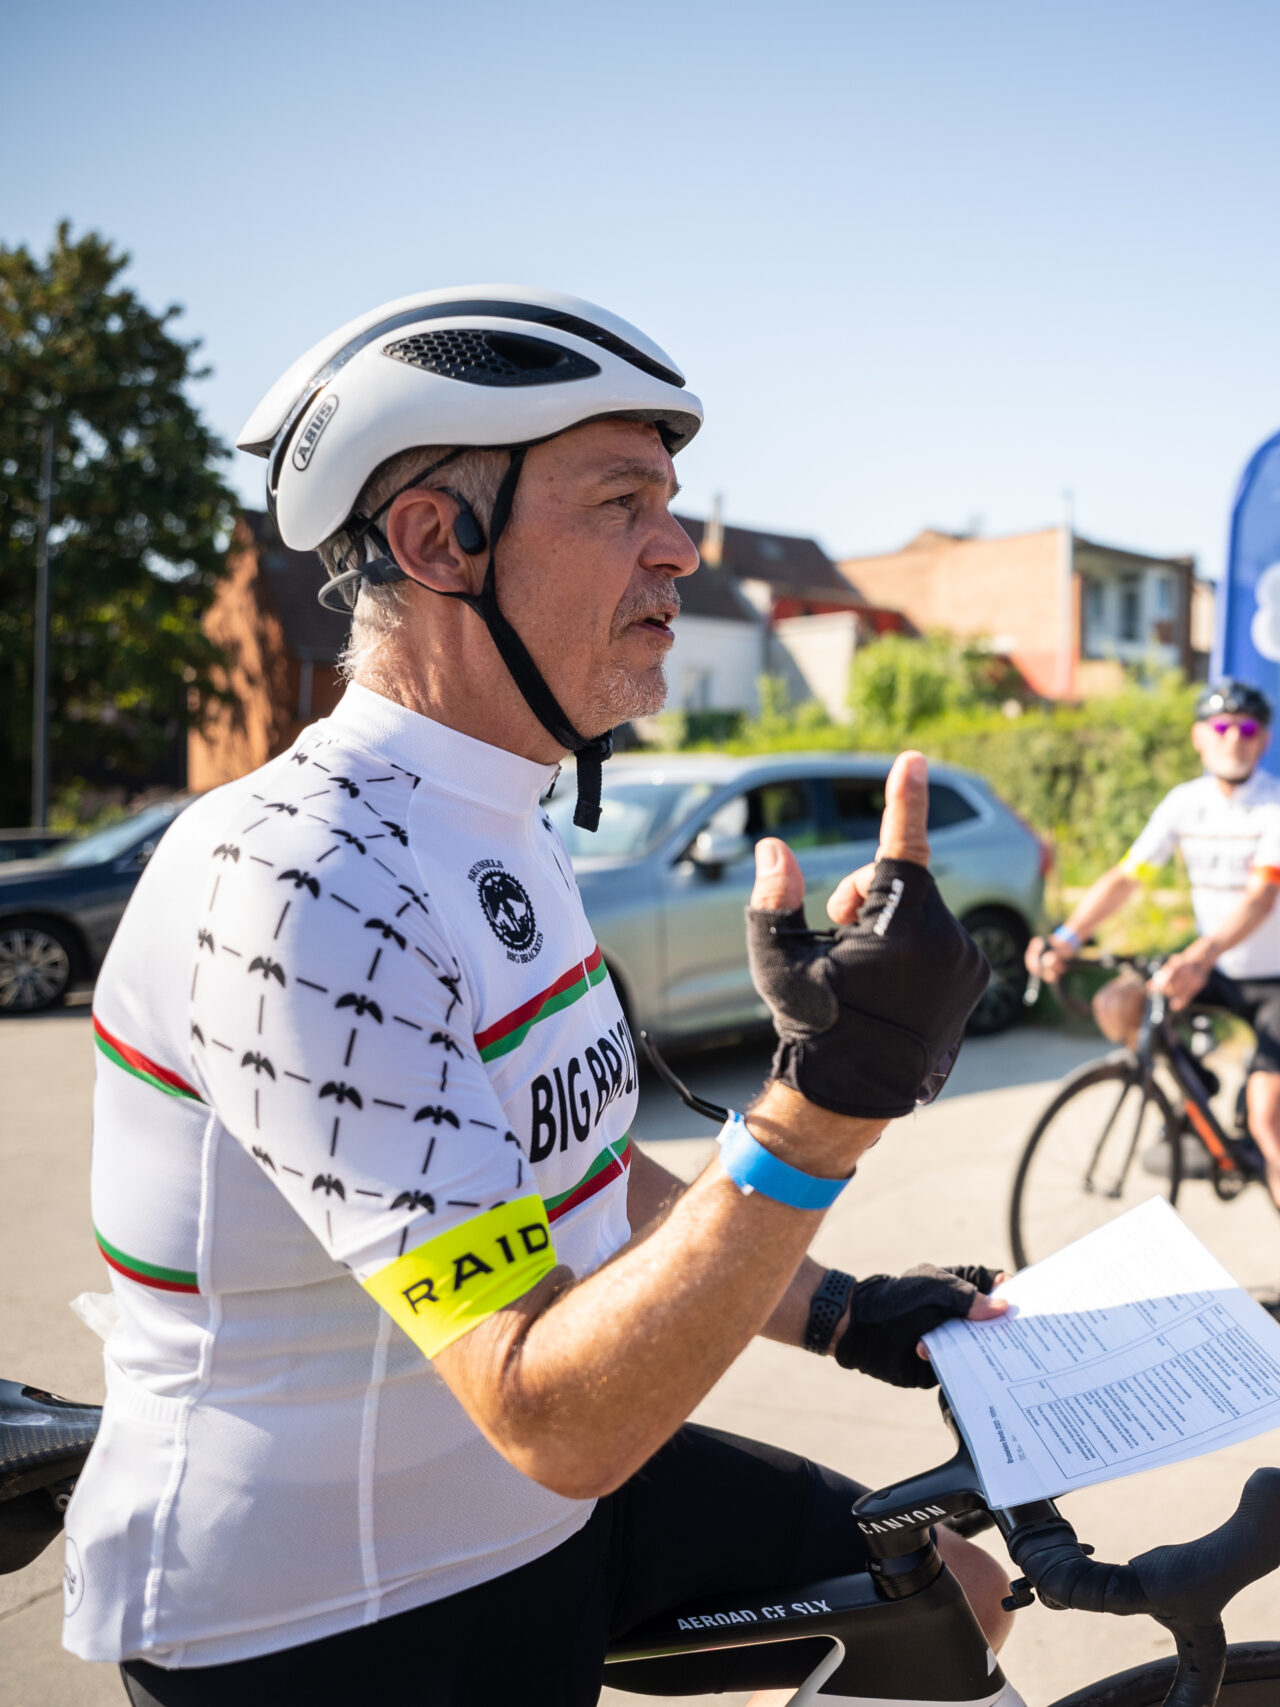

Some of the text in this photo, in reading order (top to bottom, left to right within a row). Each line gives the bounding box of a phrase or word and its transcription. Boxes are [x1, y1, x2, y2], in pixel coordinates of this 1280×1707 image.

[297, 402, 333, 462] ABUS
[467, 859, 504, 883] BRUSSELS
[506, 931, 544, 964] BIG BRACKETS
[529, 1057, 591, 1164] BIG
[402, 1222, 550, 1315] RAID
[857, 1505, 947, 1535] CANYON
[676, 1599, 833, 1631] AEROAD CF SLX
